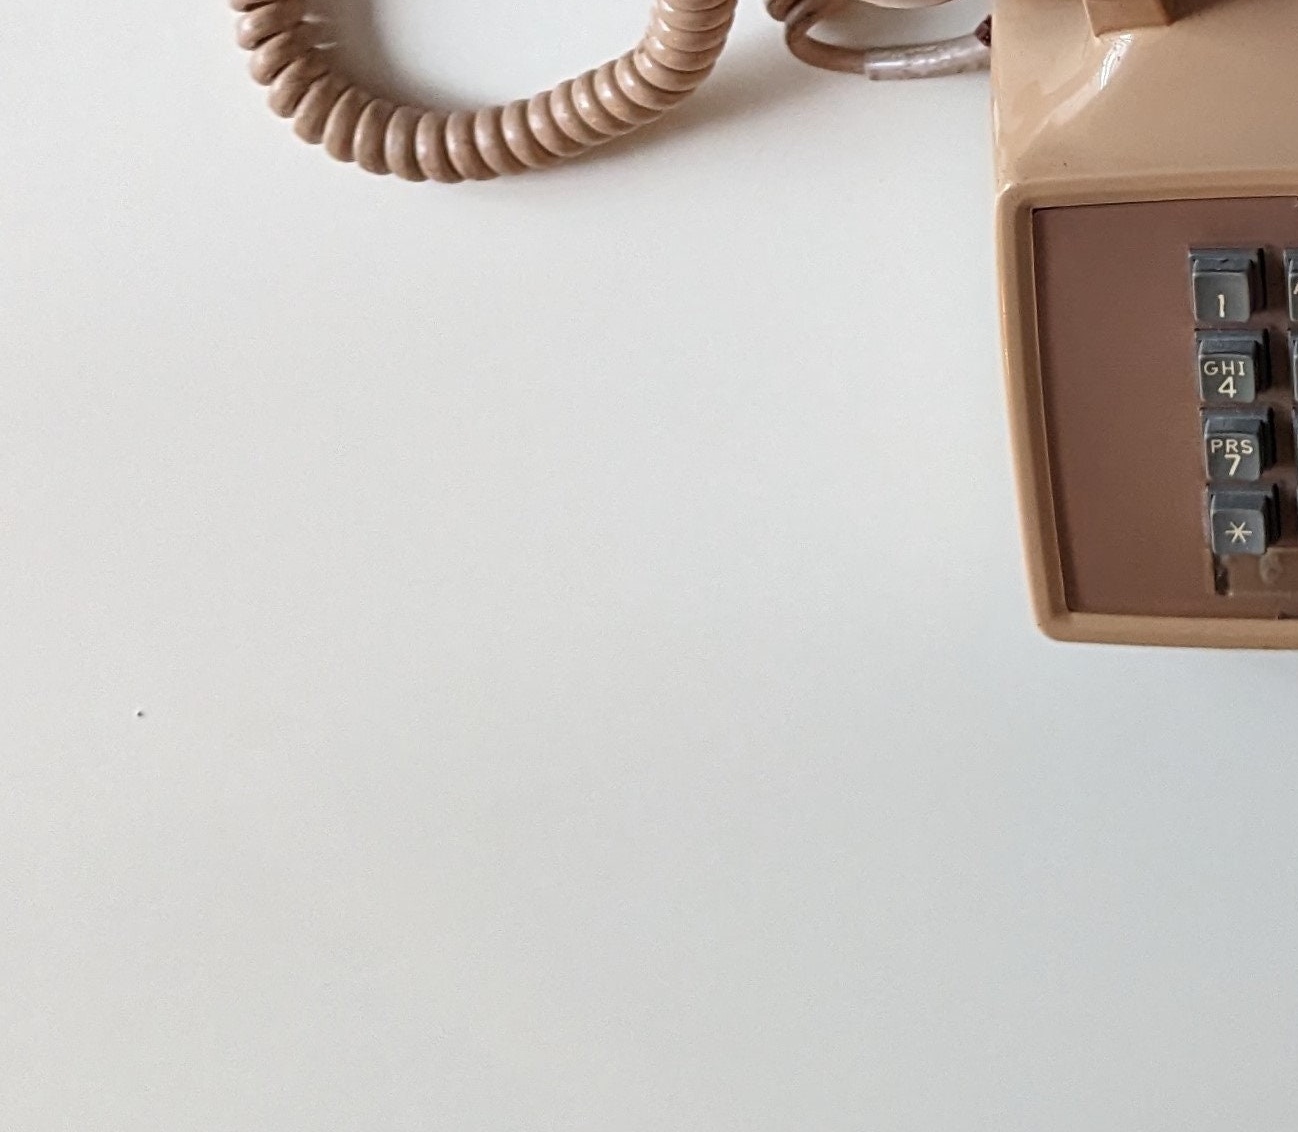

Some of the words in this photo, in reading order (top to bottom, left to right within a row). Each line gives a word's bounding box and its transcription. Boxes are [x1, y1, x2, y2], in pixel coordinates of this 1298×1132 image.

[1216, 294, 1226, 318] 1
[1204, 360, 1246, 376] GHI
[1218, 376, 1237, 398] 4
[1210, 439, 1254, 454] PRS
[1224, 454, 1242, 476] 7
